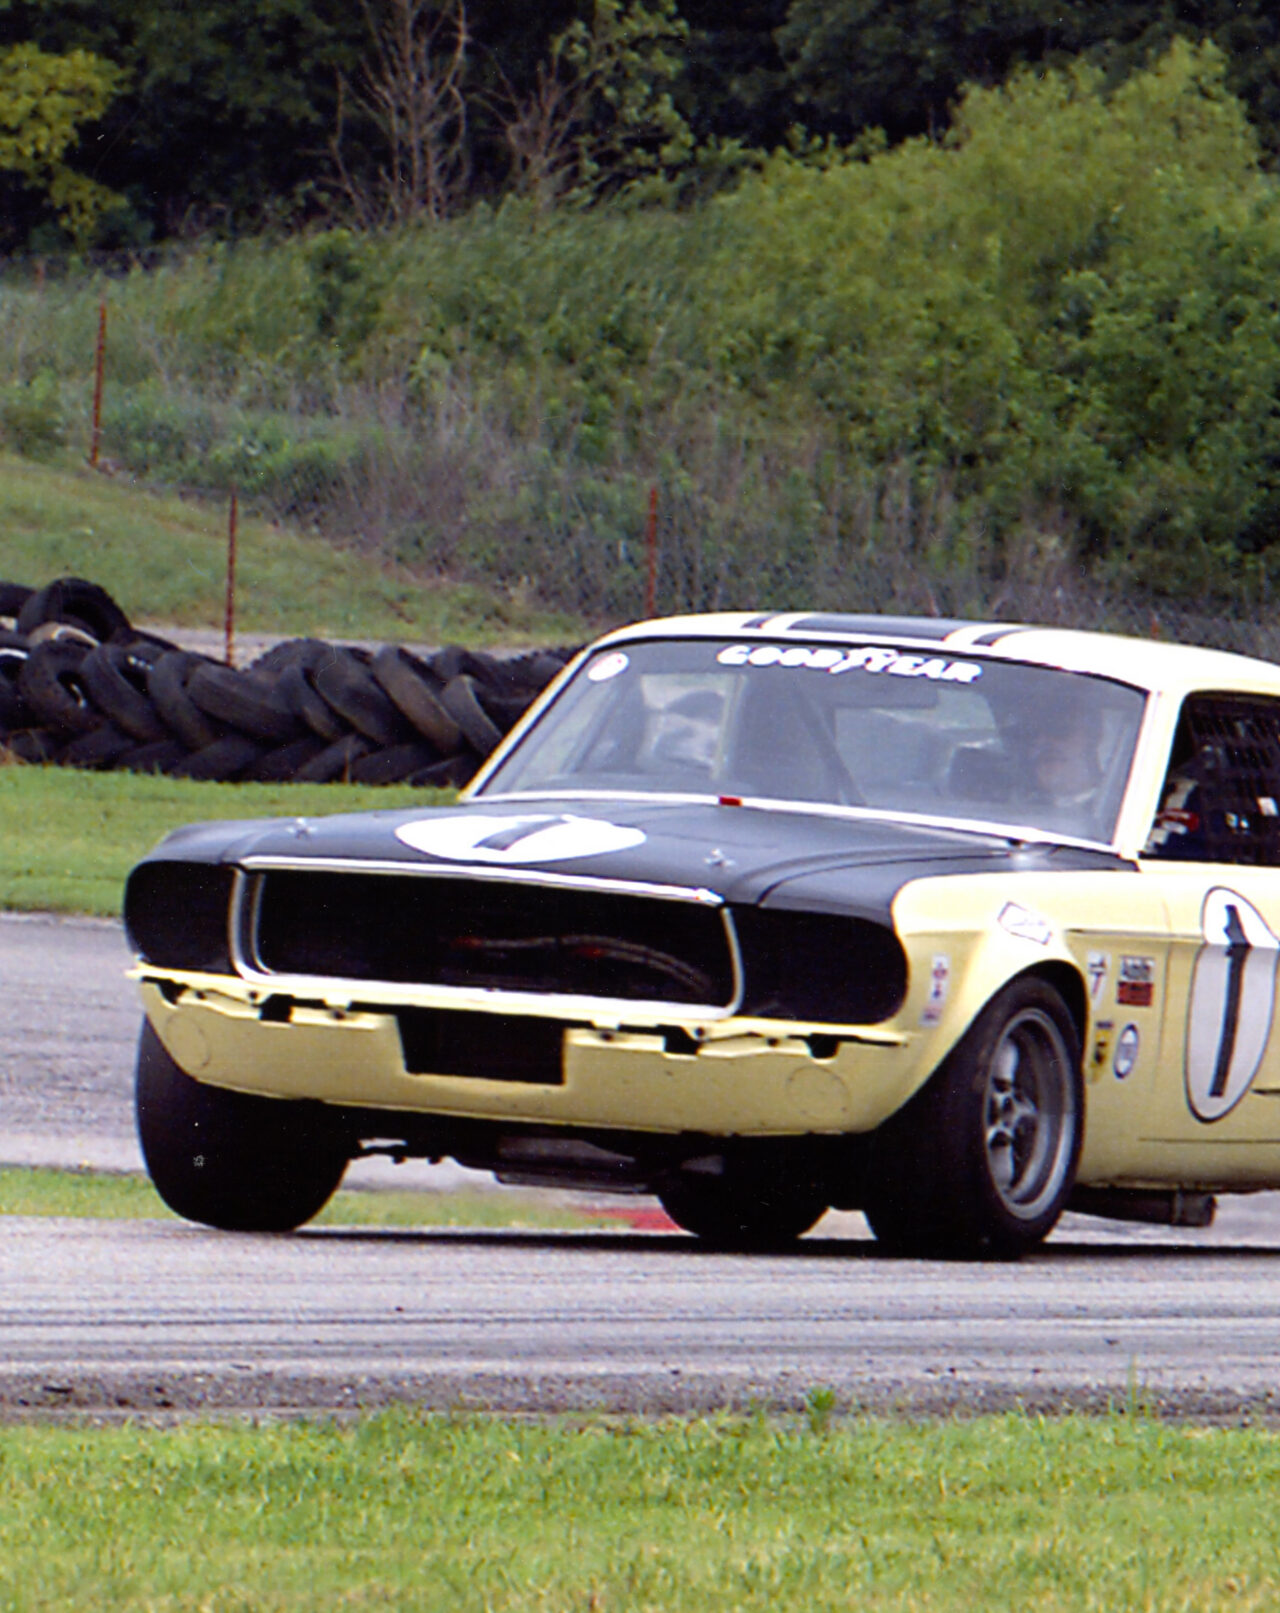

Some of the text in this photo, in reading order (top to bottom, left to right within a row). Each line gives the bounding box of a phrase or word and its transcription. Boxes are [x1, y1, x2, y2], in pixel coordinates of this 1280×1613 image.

[717, 645, 982, 683] GOODYEAR
[471, 815, 571, 852] 1
[1207, 904, 1252, 1097] 1
